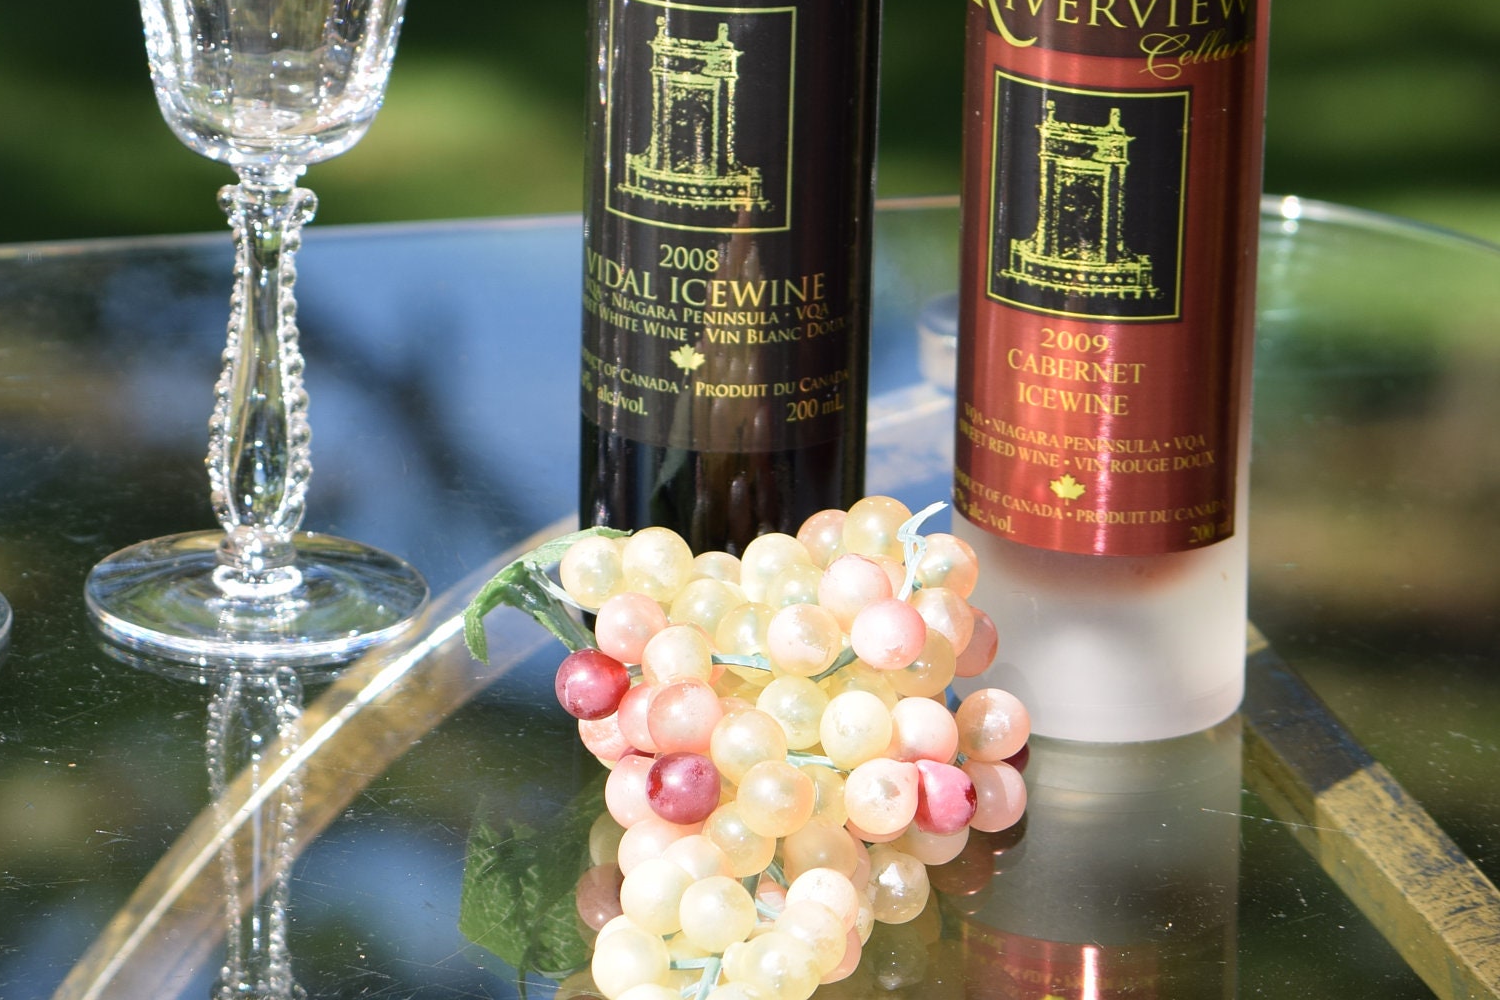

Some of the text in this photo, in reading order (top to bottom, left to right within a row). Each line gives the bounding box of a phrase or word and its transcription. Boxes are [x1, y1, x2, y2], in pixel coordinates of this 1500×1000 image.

[586, 246, 658, 300] VIDAL
[659, 244, 720, 272] 2008
[670, 273, 825, 308] ICEWINE
[600, 302, 638, 333] WHITE
[643, 319, 688, 341] WINE
[707, 328, 740, 344] VIN
[747, 327, 802, 344] BLANC
[612, 292, 678, 322] NIAGARA
[683, 309, 779, 326] PENINSULA
[796, 302, 829, 320] VQA
[1040, 328, 1109, 353] 2009
[620, 368, 679, 394] CANADA
[695, 381, 768, 398] PRODUIT
[773, 382, 796, 396] DU
[1007, 348, 1146, 383] CABERNET
[786, 398, 819, 422] 200
[822, 393, 845, 415] mL
[1018, 382, 1130, 415] ICEWINE
[992, 417, 1060, 449] NIAGARA
[1064, 436, 1161, 453] PENINSULA
[1173, 434, 1206, 450] VQA
[989, 436, 1016, 457] RED
[1018, 446, 1060, 467] WINE
[1075, 457, 1104, 473] VIN
[1111, 456, 1169, 473] ROUGE
[1173, 451, 1215, 468] DOUX
[985, 488, 1001, 503] OF
[1002, 494, 1063, 520] CANADA
[1076, 509, 1146, 524] PRODUIT
[1150, 510, 1173, 523] DU
